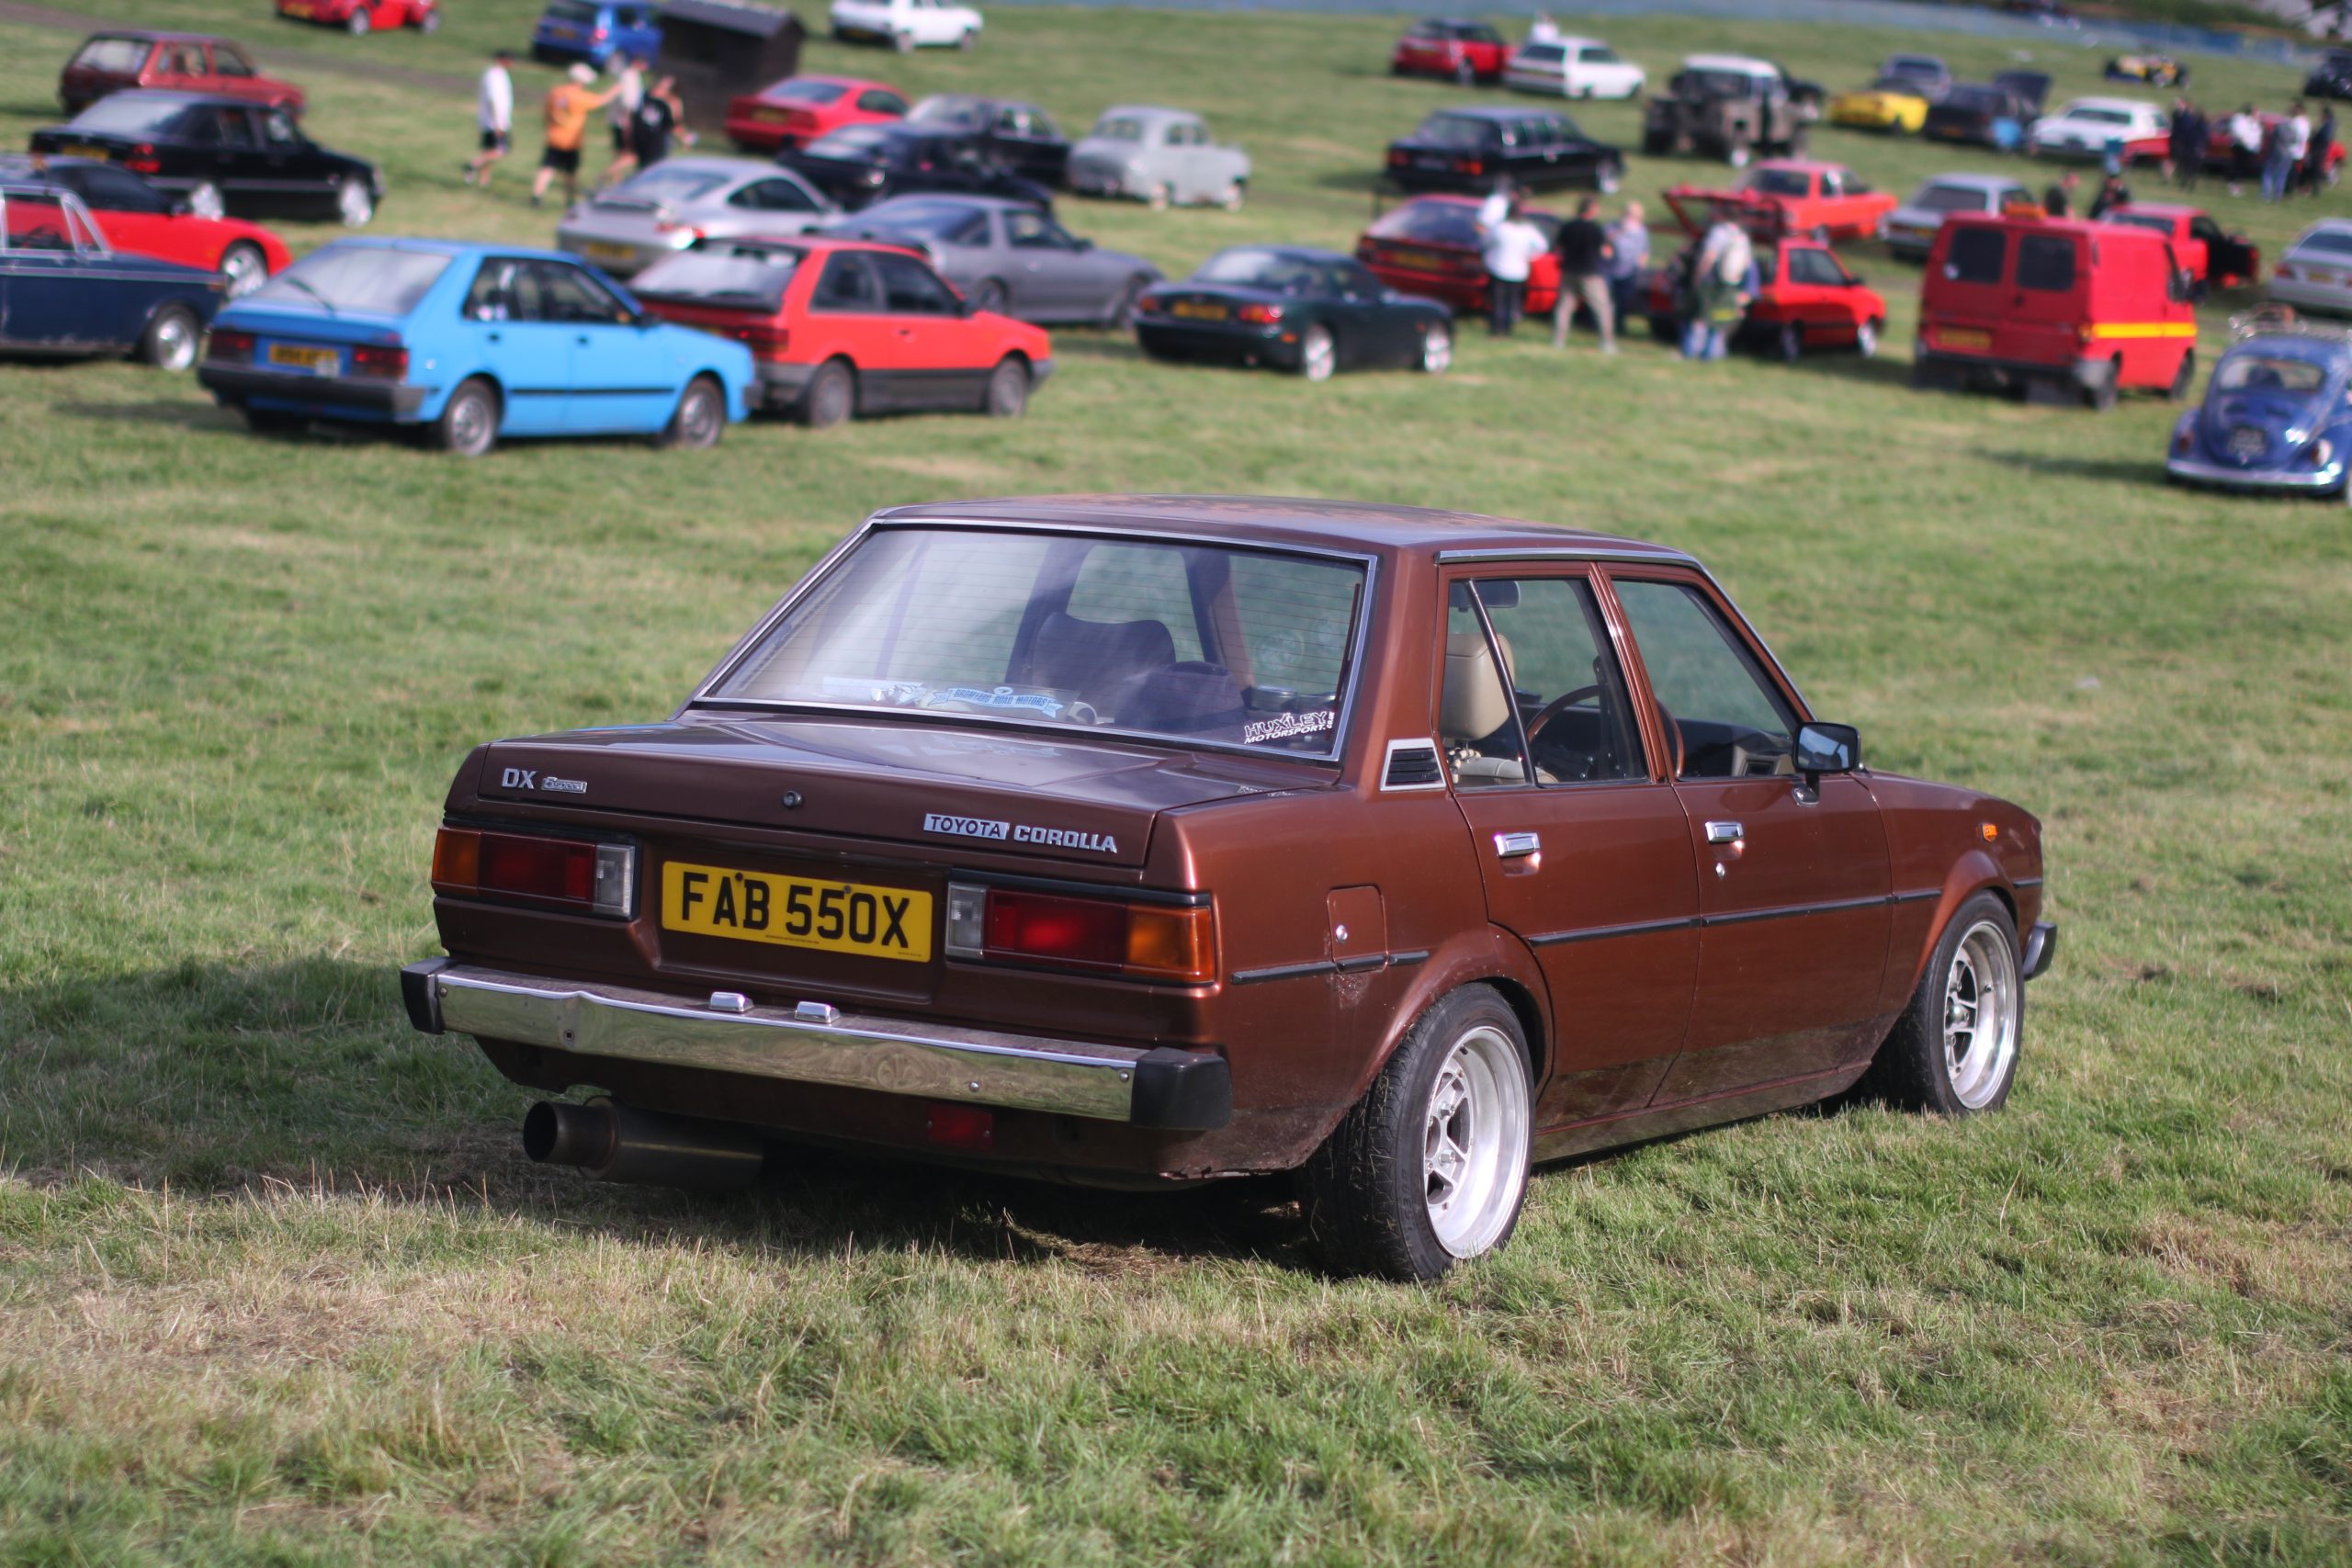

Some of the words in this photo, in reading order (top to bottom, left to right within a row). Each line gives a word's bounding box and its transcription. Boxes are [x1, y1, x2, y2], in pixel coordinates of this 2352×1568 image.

[992, 696, 1013, 705] ROAD
[1015, 696, 1047, 706] MOTORS
[1245, 711, 1327, 737] HUXLEY
[502, 767, 537, 790] DX
[930, 815, 1001, 839] TOYOTA
[1012, 825, 1117, 853] COROLLA
[682, 871, 770, 931] FAB
[786, 885, 910, 948] 550X
